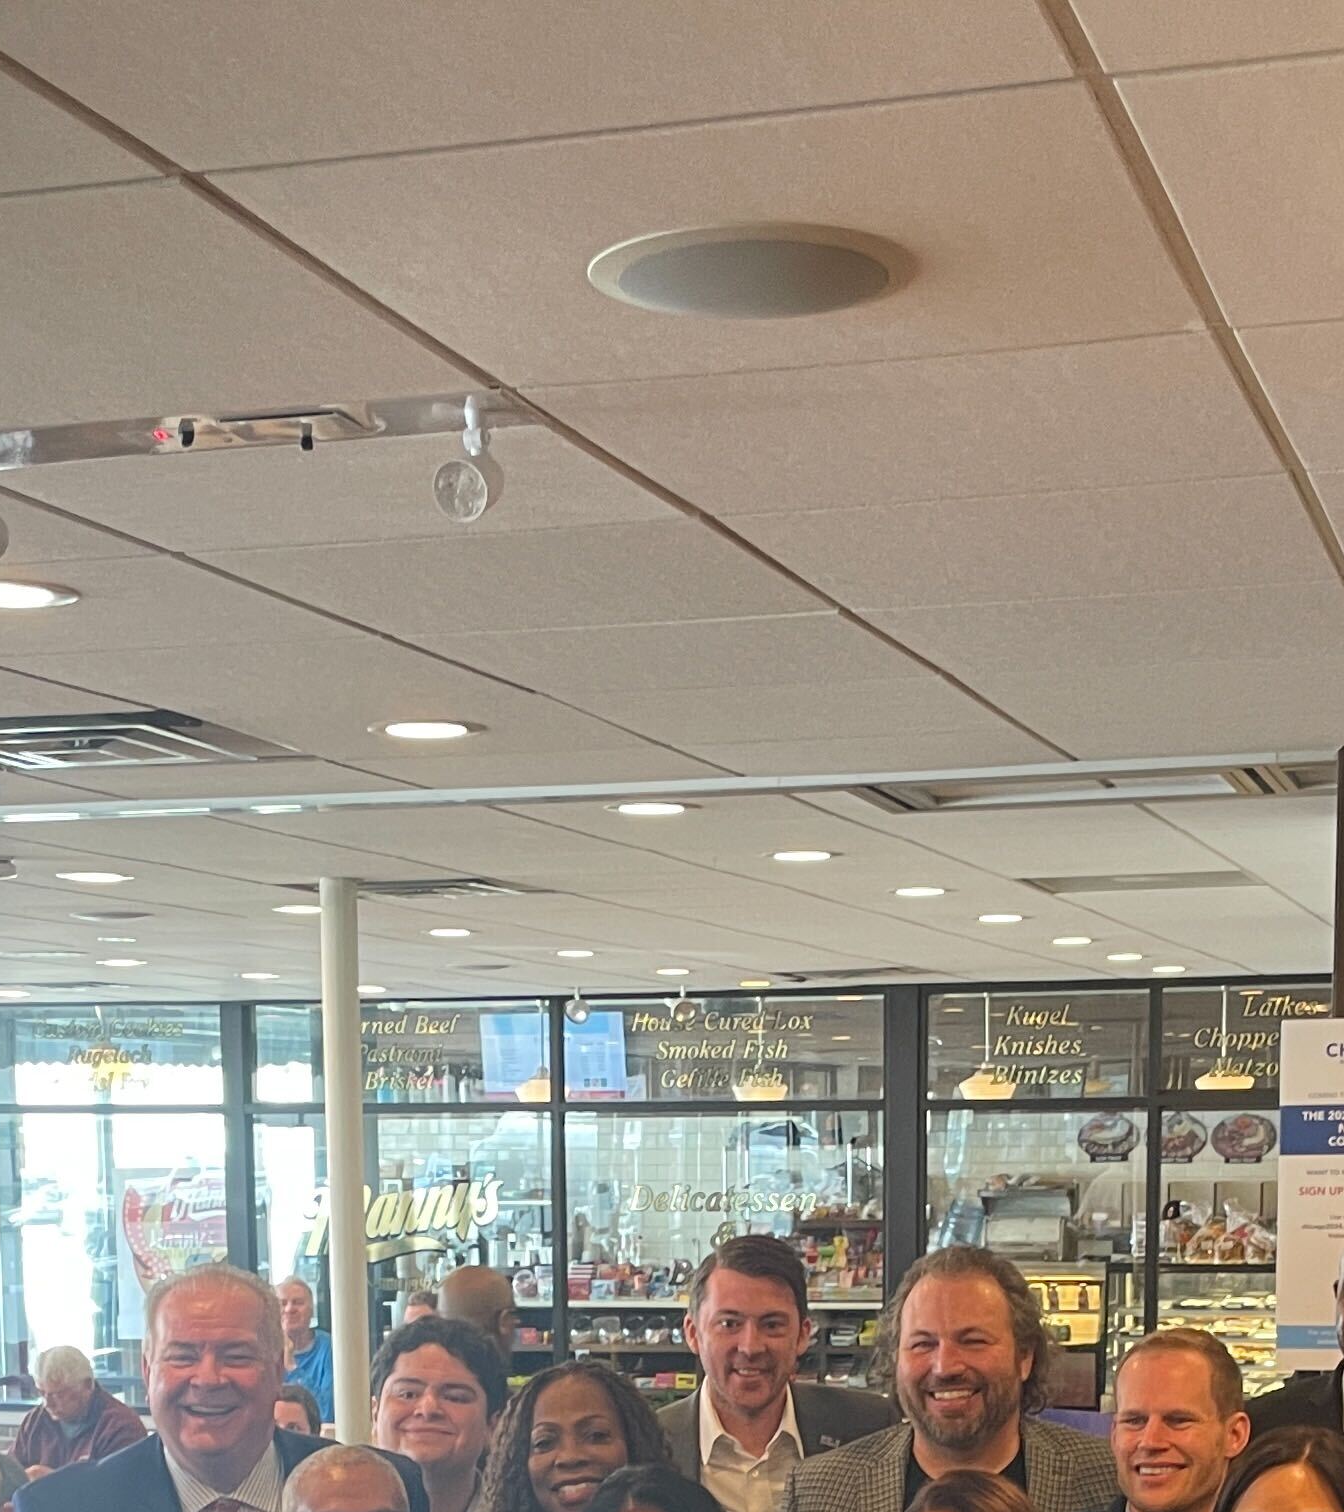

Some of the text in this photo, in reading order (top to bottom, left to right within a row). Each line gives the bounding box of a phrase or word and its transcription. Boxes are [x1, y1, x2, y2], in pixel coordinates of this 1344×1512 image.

[1006, 1004, 1070, 1029] Kugel
[1243, 995, 1319, 1017] Latkes
[360, 1013, 461, 1035] rned Beef
[631, 1010, 814, 1032] House Cured Lox
[655, 1039, 789, 1060] Smoked Fish
[994, 1033, 1083, 1056] Knishes
[1194, 1027, 1280, 1051] Choppe
[67, 1044, 153, 1068] Rugelach
[1210, 1057, 1279, 1077] Matzo
[364, 1069, 435, 1091] Brisket
[738, 1068, 784, 1088] Fish
[990, 1065, 1084, 1086] Blintzes
[1301, 1111, 1324, 1121] THE
[628, 1184, 817, 1213] Delicatessen
[1298, 1186, 1326, 1196] SIGN
[1329, 1186, 1344, 1196] UP
